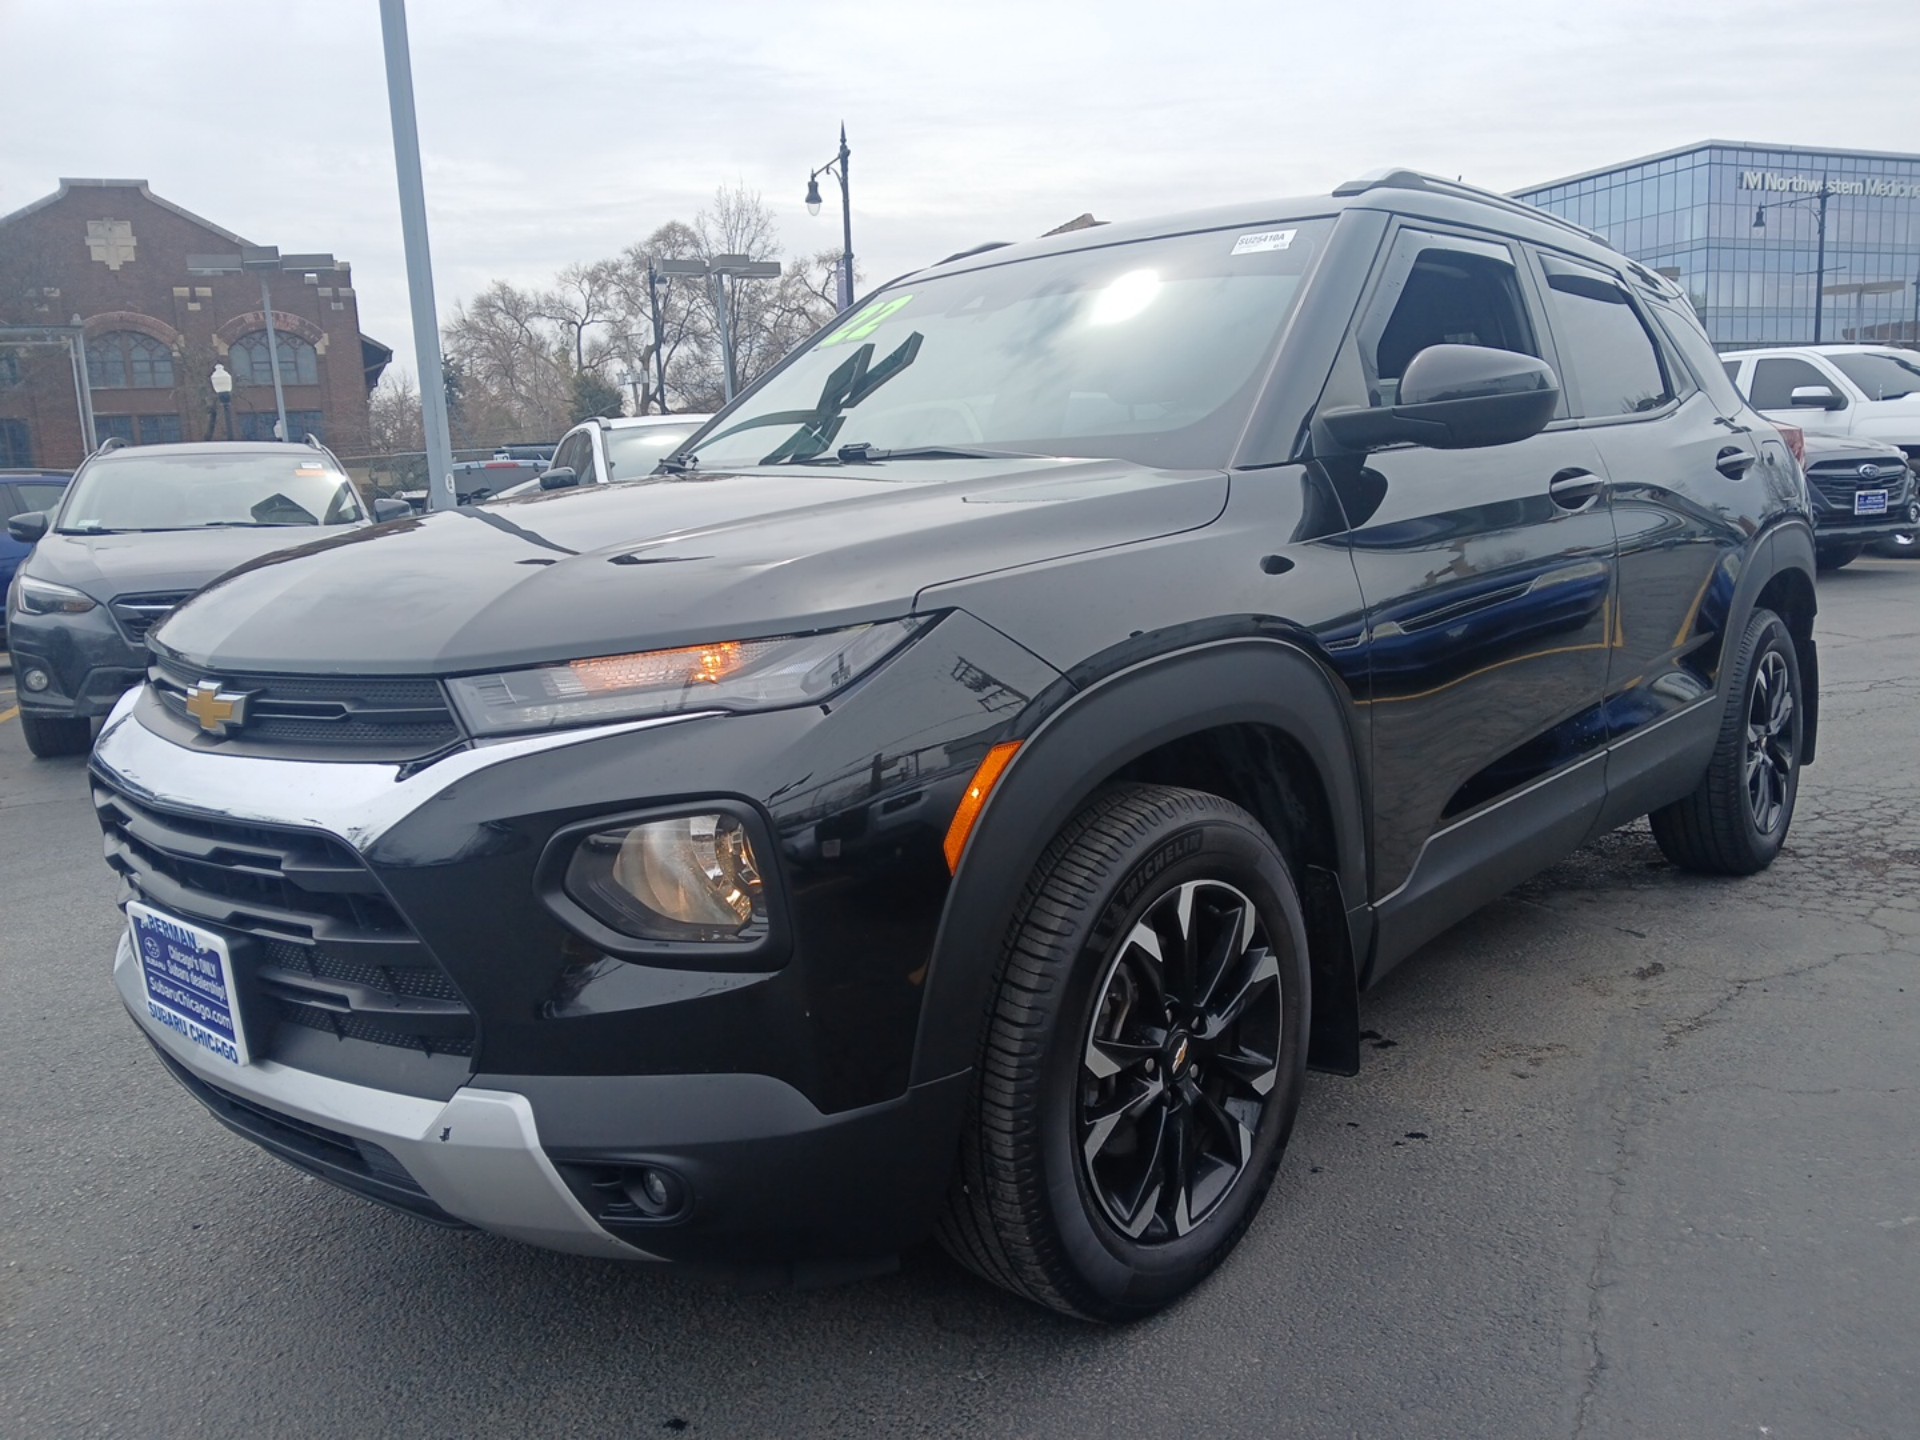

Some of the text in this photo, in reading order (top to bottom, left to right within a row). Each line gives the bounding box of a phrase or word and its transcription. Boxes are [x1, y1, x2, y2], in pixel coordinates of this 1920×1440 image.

[1764, 172, 1864, 196] Northwstern
[1122, 831, 1202, 902] MICHELIN
[166, 959, 190, 983] Subaru
[199, 958, 217, 979] ONLY
[149, 976, 233, 1030] SubaruChicago.com
[148, 1001, 239, 1064] SUBARU CHICAGO
